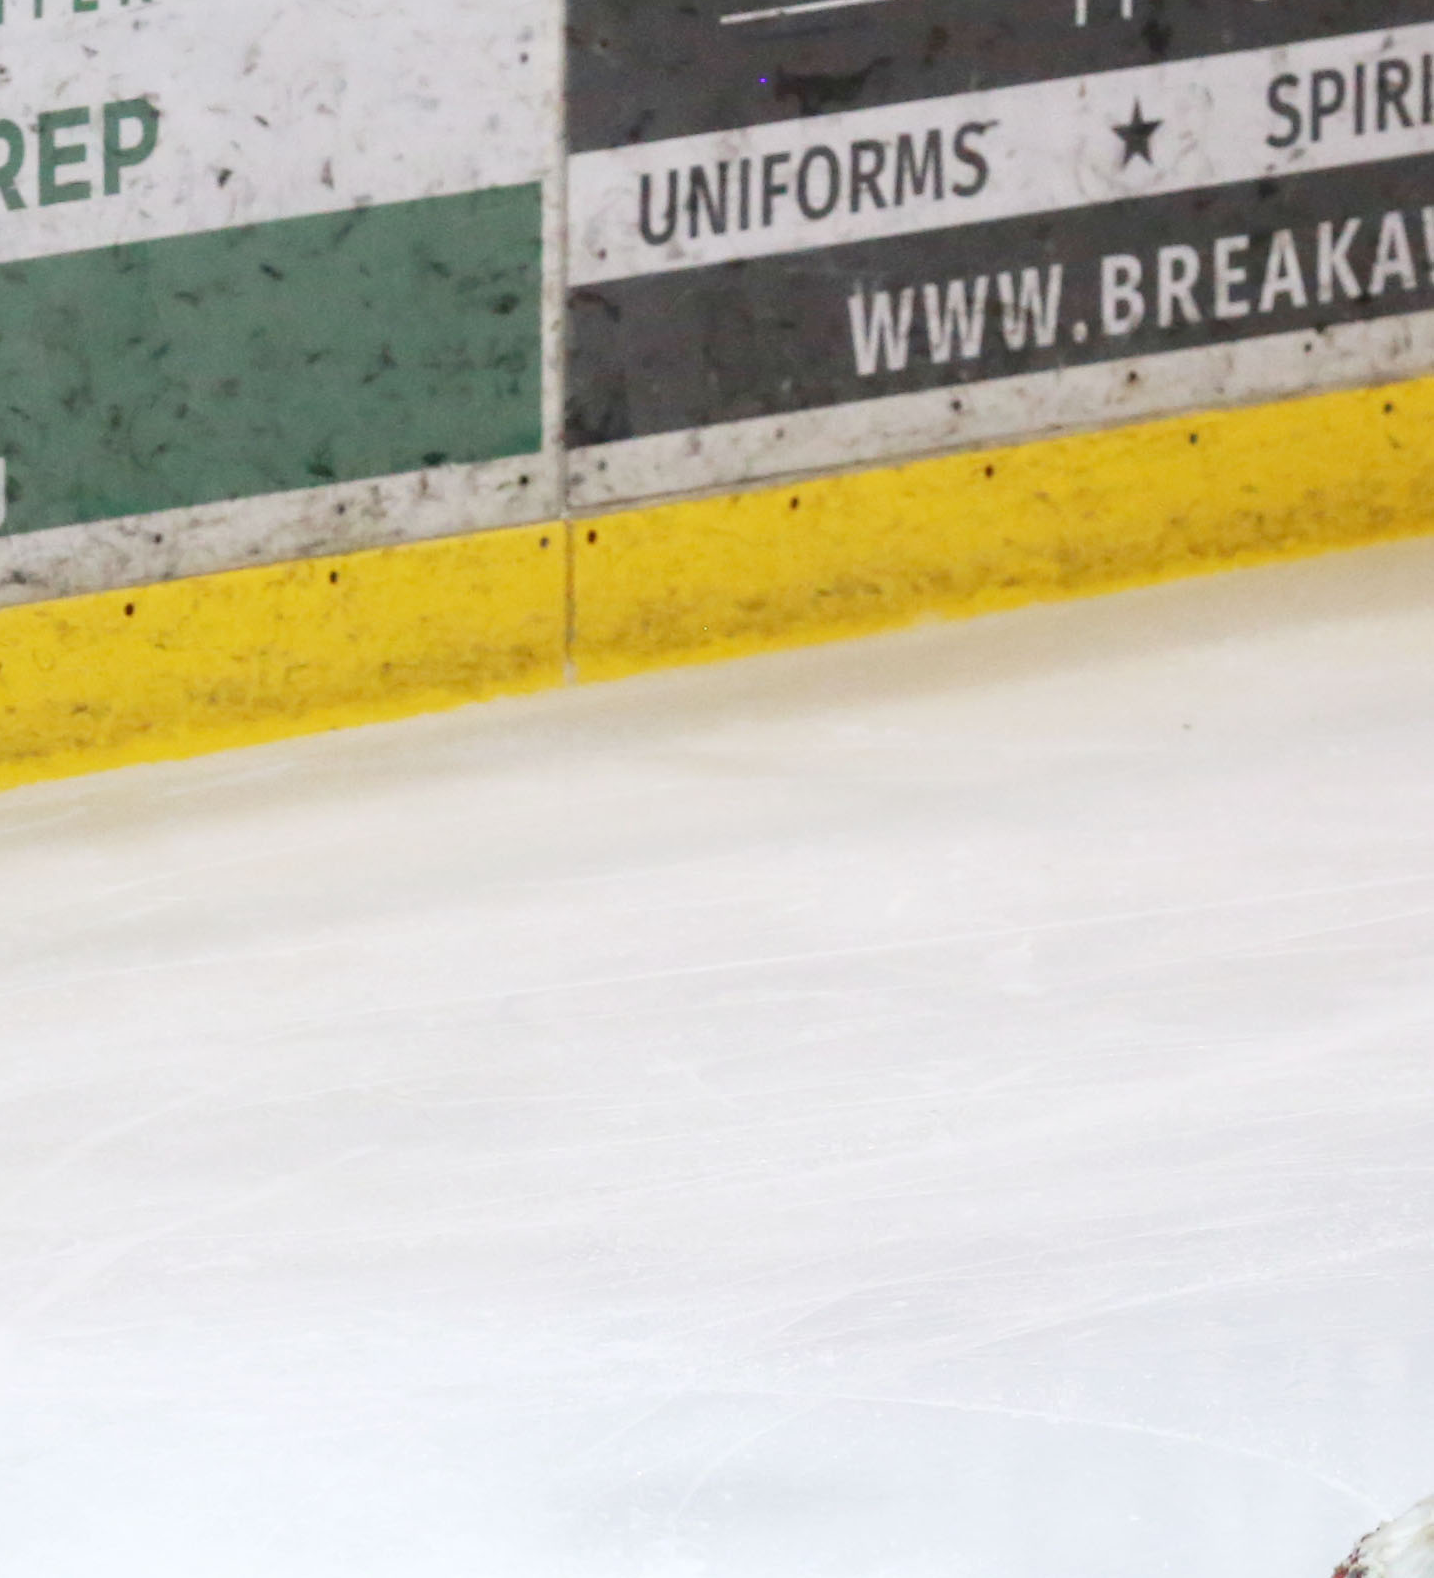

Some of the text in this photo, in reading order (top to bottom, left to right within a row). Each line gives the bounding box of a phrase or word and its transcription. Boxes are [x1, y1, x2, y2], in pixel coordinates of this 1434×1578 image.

[638, 53, 1434, 246] UNIFORMS SPIRI
[848, 204, 1434, 376] WWW.BREAKA
